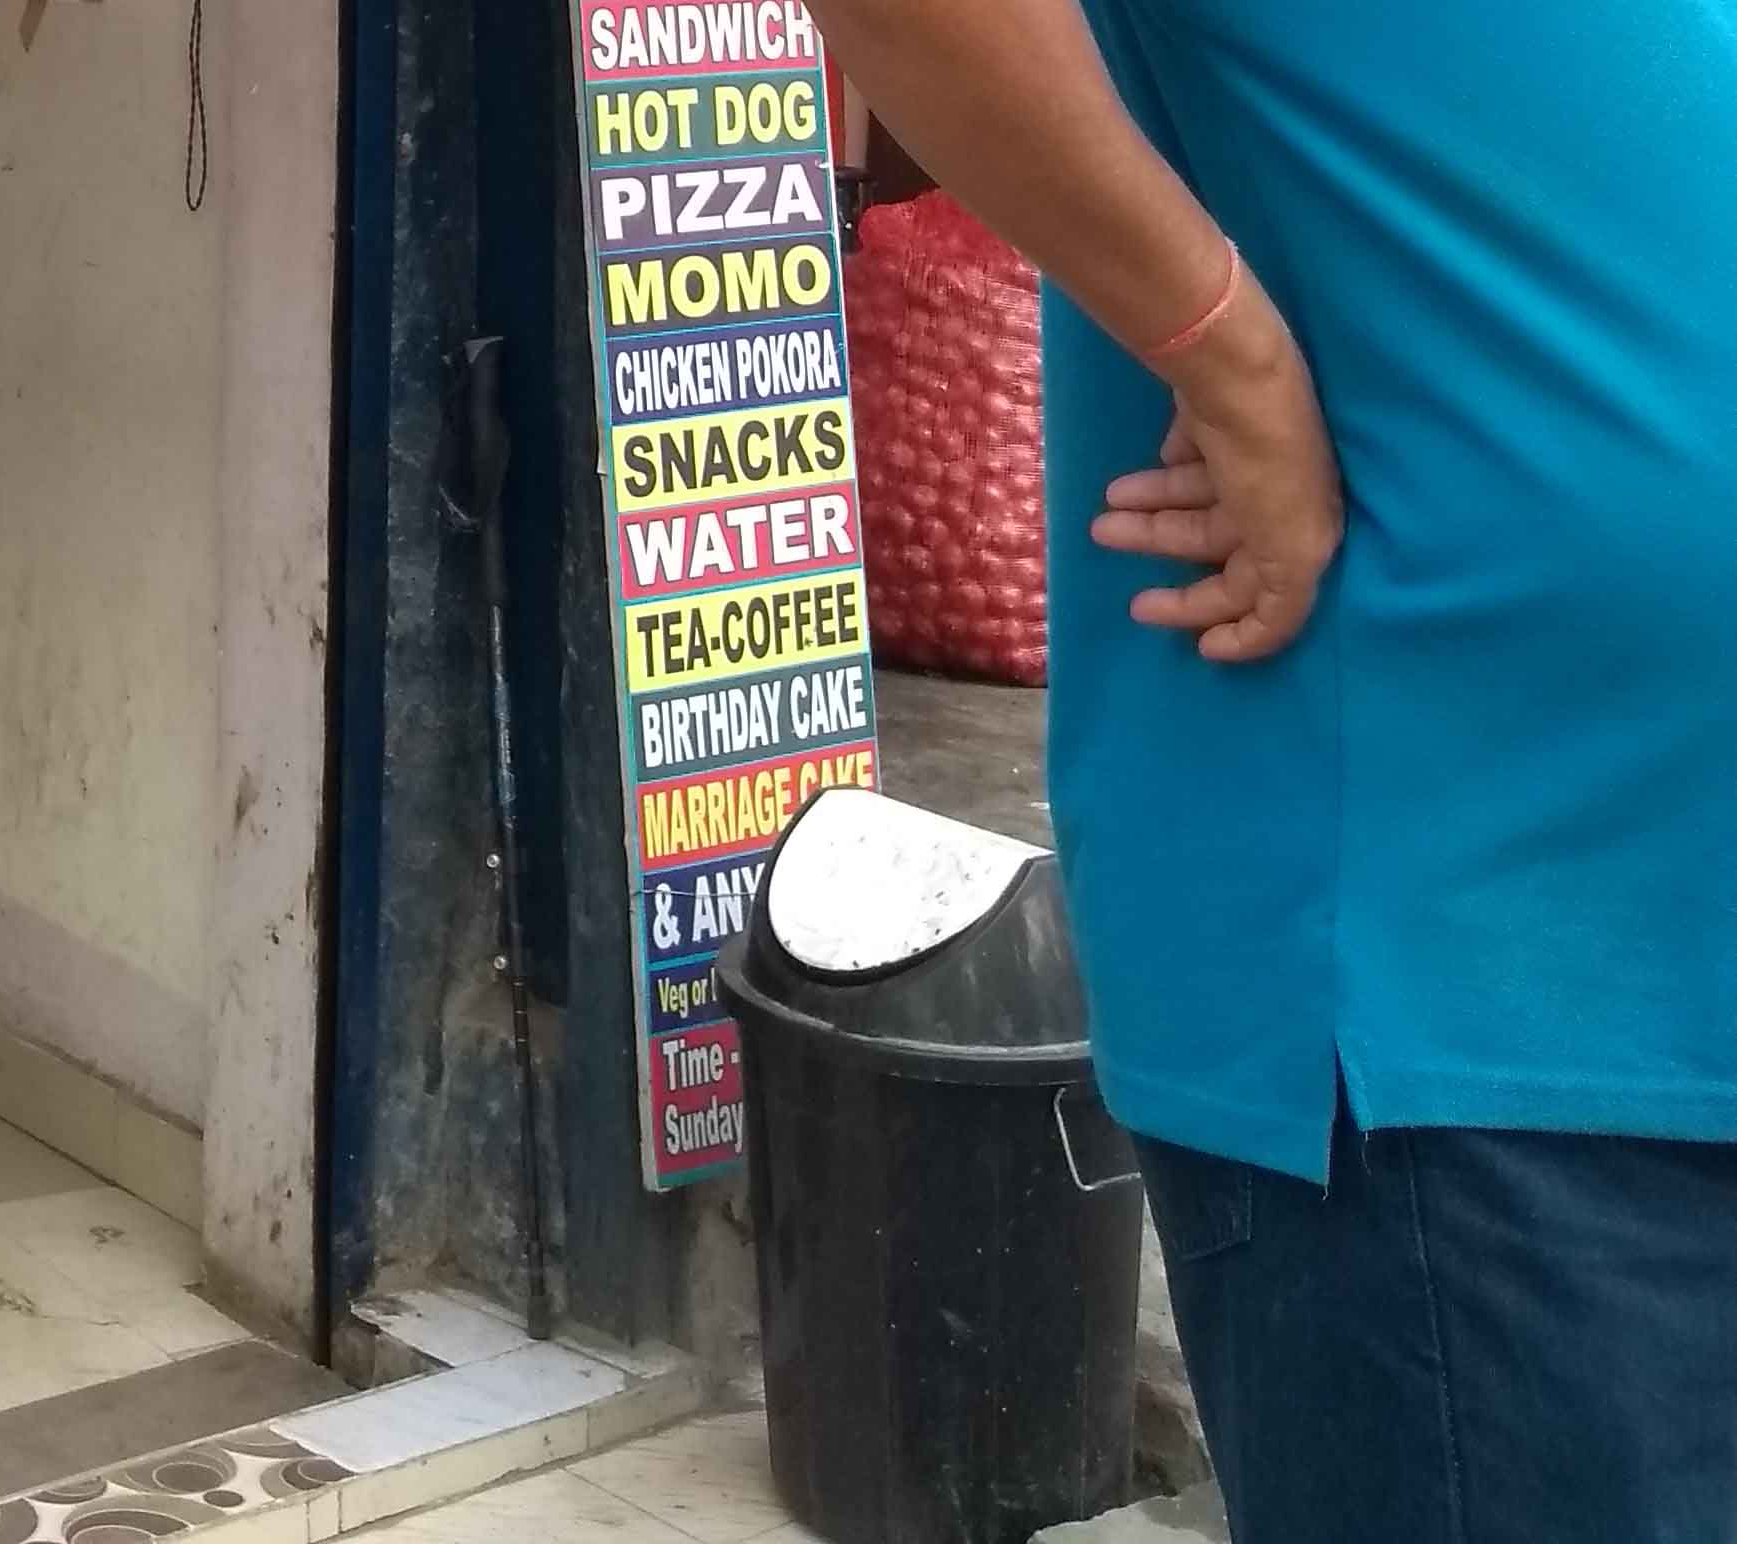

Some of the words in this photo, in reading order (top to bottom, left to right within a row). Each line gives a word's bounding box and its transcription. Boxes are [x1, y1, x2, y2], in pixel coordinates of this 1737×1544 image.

[591, 0, 815, 71] SANDWICH
[596, 88, 699, 155] HOT
[714, 81, 817, 146] DOG
[600, 163, 823, 241] PIZZA
[607, 244, 831, 326] MOMO
[615, 341, 733, 415] CHICKEN
[735, 328, 841, 400] POKORA
[623, 410, 845, 498] SNACKS
[625, 493, 856, 588] WATER
[636, 581, 859, 678] TEA-COFFEE
[641, 680, 782, 768] BIRTHDAY
[790, 665, 867, 740] CAKE
[642, 766, 793, 859] MARRIAGE
[652, 882, 682, 949] &
[658, 976, 689, 1019] Veg
[691, 977, 709, 1007] or
[662, 1038, 724, 1091] Time
[664, 1094, 744, 1155] Sunday
